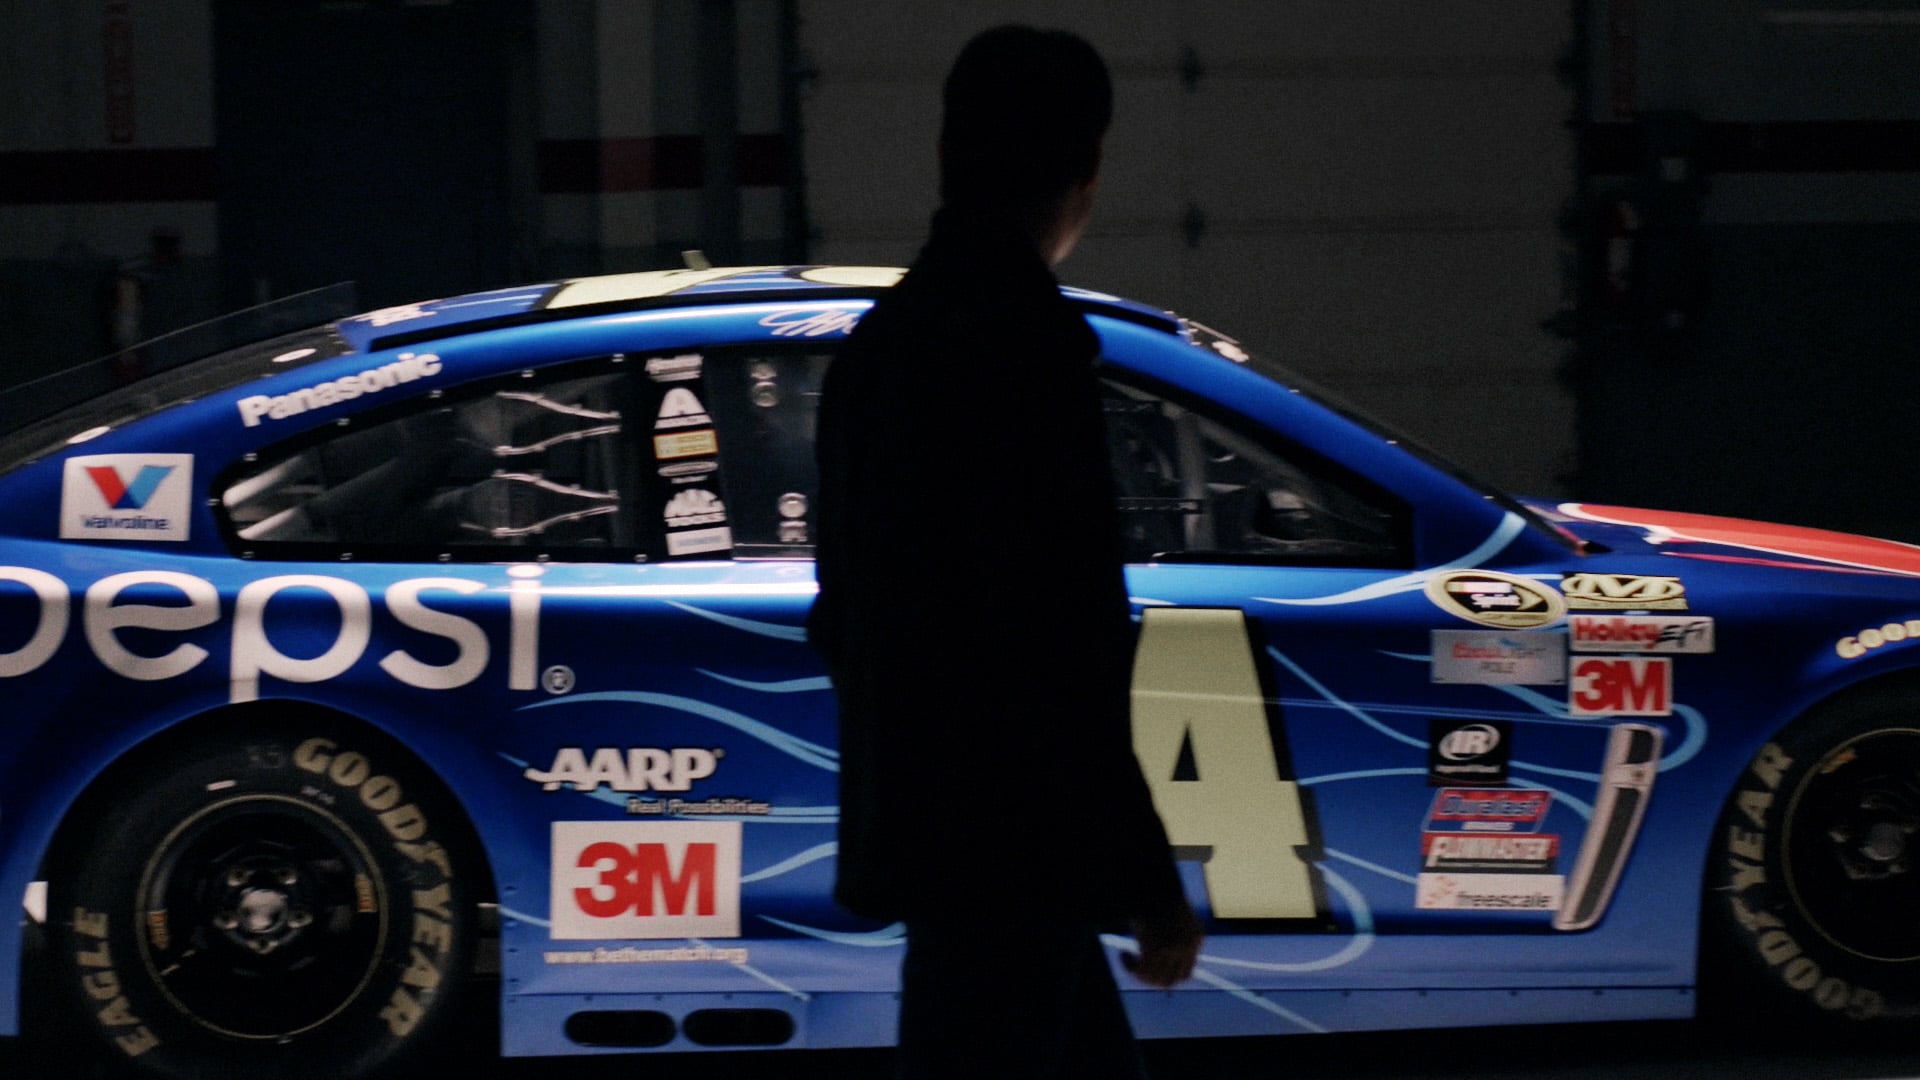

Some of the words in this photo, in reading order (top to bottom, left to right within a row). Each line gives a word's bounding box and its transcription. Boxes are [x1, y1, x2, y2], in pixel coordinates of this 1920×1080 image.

[237, 353, 442, 427] Panasonic
[81, 514, 169, 530] Valvoline
[1574, 617, 1659, 649] Holley
[1572, 660, 1664, 711] 3M
[524, 747, 718, 792] AARP
[292, 737, 456, 1038] GOODYEAR
[574, 842, 716, 918] 3M
[1457, 890, 1552, 908] freescale
[73, 905, 160, 1057] EAGLE
